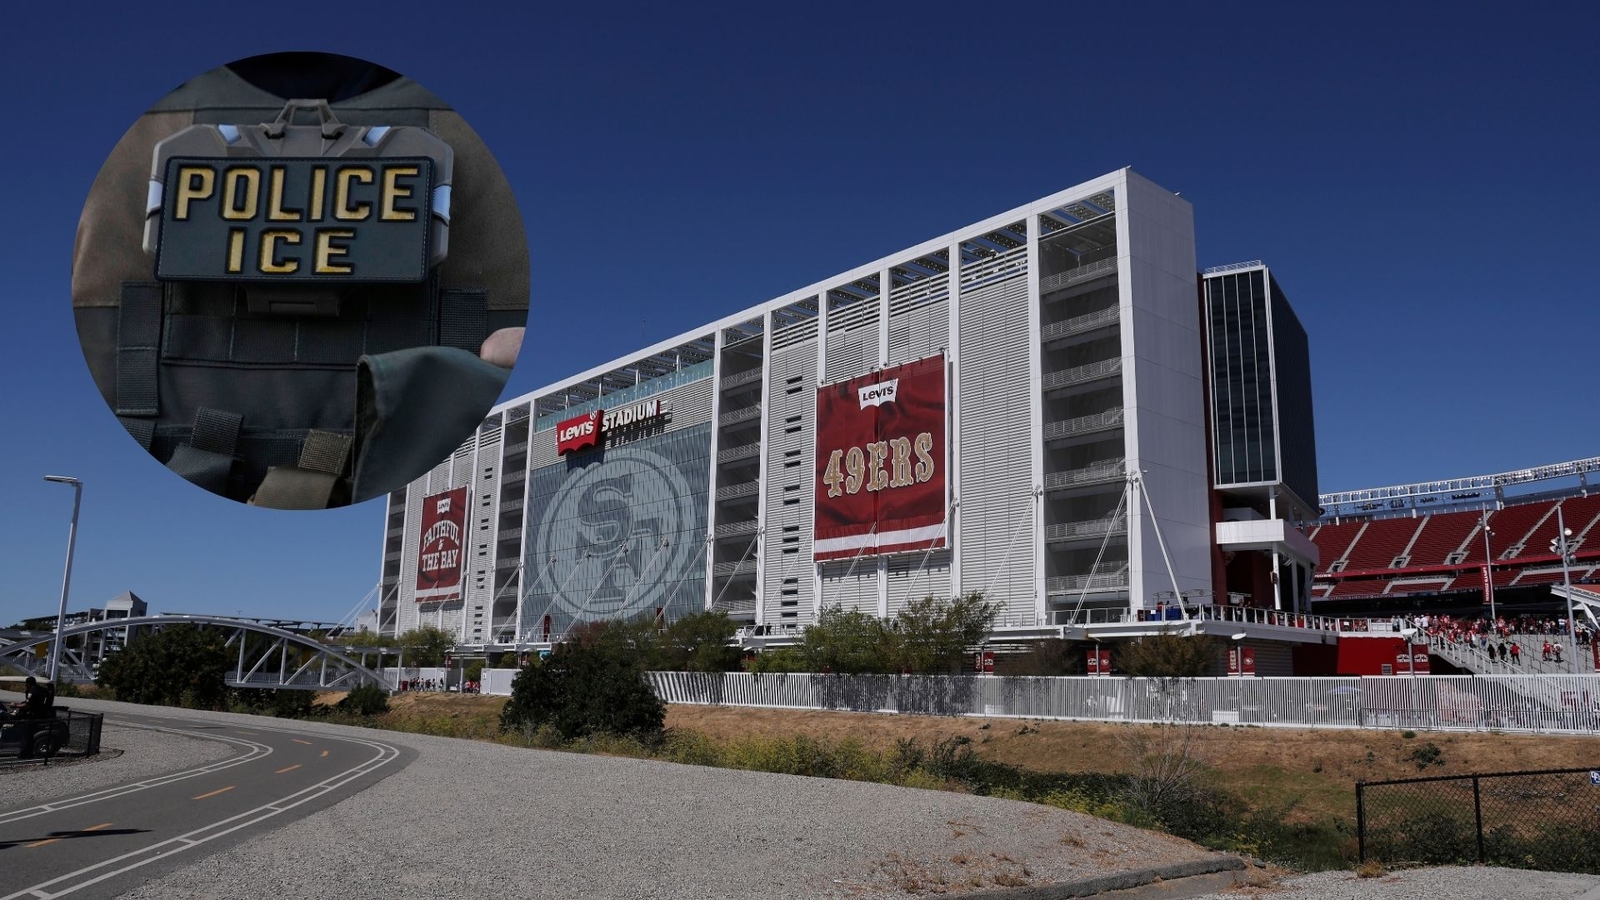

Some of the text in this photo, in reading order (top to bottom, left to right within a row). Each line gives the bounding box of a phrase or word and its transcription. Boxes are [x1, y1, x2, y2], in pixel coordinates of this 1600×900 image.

[172, 163, 420, 222] POLICE
[225, 226, 357, 275] ICE
[601, 400, 659, 432] STADIUM
[823, 432, 935, 498] 49ERS
[423, 520, 460, 552] FAITHFUL
[422, 549, 459, 572] THE BAY
